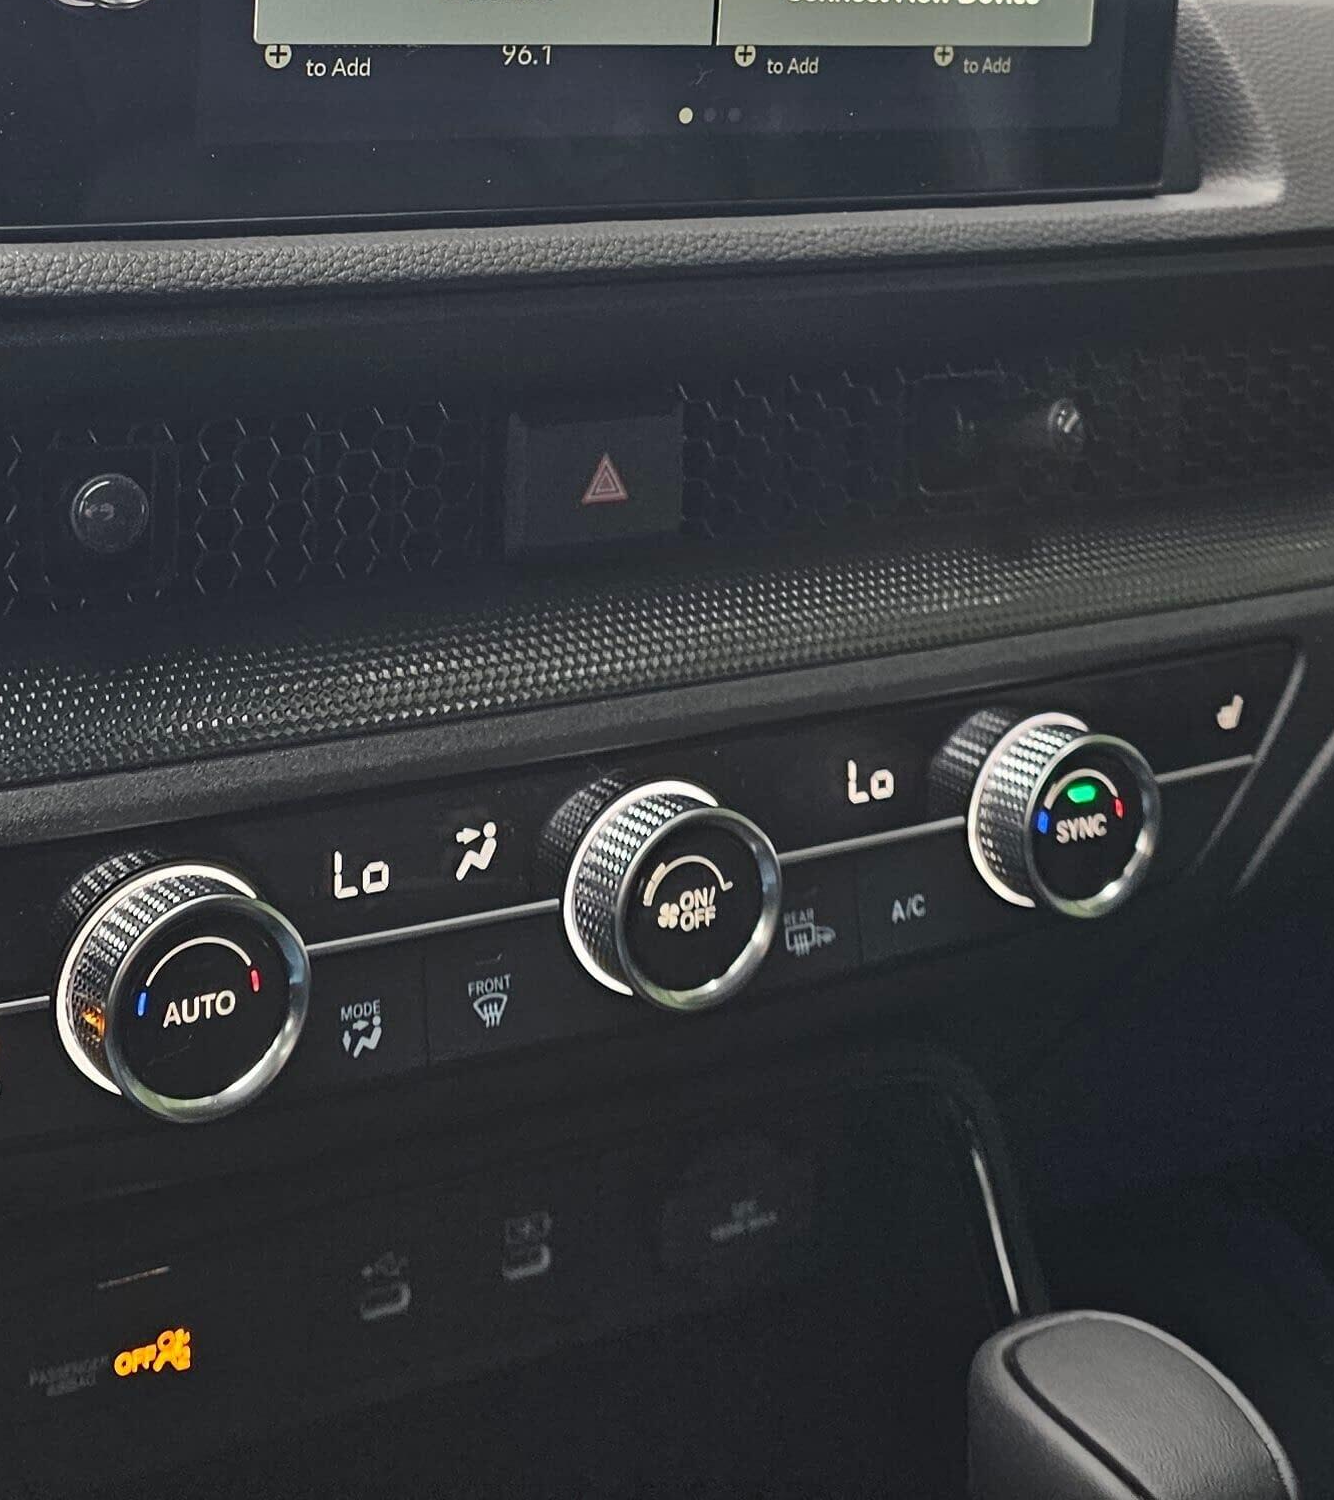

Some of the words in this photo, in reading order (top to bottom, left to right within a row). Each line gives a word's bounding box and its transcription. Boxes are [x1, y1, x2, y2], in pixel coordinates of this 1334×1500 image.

[305, 59, 327, 77] to
[331, 57, 371, 77] Add
[502, 44, 552, 66] 96.1
[767, 58, 784, 75] to
[787, 57, 819, 75] Add
[964, 58, 979, 74] to
[982, 57, 1011, 75] Add
[847, 759, 895, 805] Lo
[1056, 812, 1109, 844] SYNC
[333, 850, 390, 899] Lo
[679, 886, 716, 911] ON/
[891, 893, 928, 925] A/C
[679, 906, 716, 932] OFF
[783, 908, 815, 926] REAR
[468, 973, 513, 998] FRONT
[162, 989, 237, 1028] AUTO
[340, 999, 382, 1022] MODE
[114, 1344, 158, 1377] OFF
